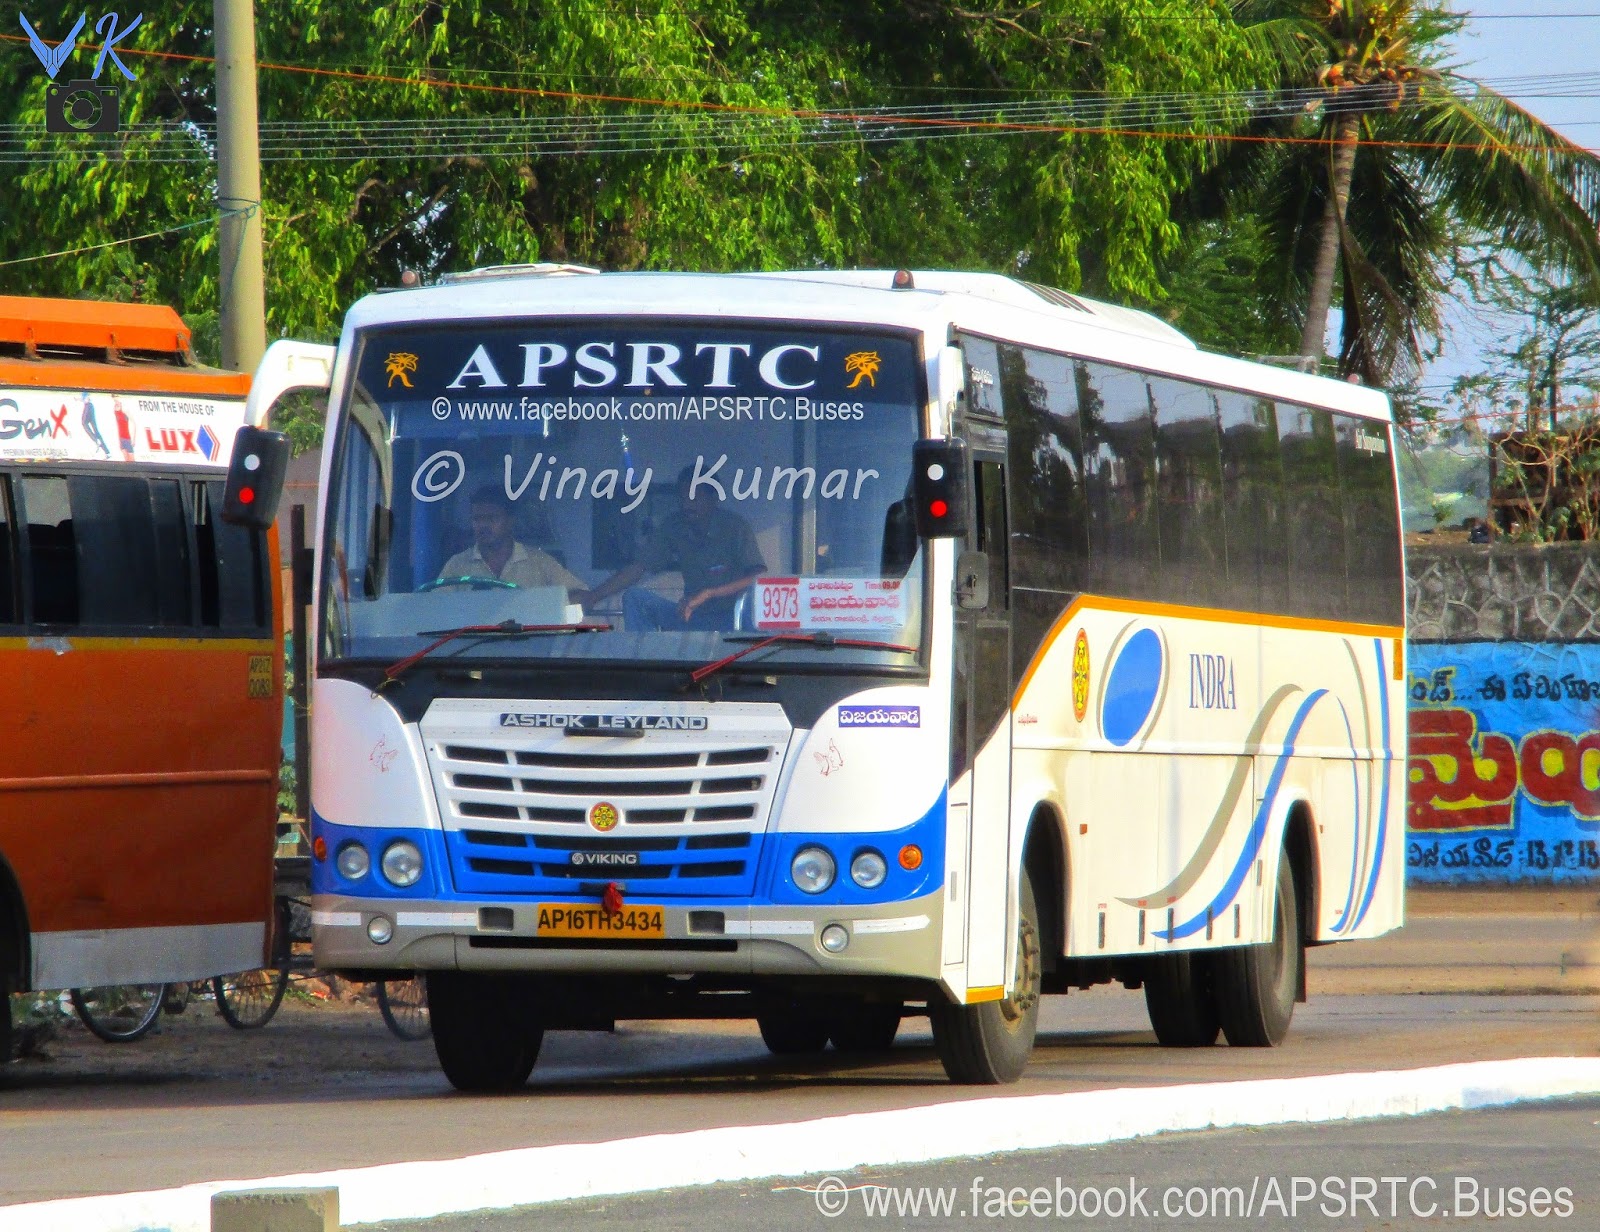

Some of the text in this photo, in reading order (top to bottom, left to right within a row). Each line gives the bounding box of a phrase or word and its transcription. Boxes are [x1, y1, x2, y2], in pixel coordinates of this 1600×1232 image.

[446, 342, 821, 390] APSRTC
[138, 400, 215, 417] FROM THE HOUSE OF
[144, 427, 199, 454] LUX
[763, 586, 799, 619] 9373
[1188, 653, 1237, 710] INDRA
[503, 713, 707, 730] ASHOK LEYLAND
[839, 708, 920, 725] విజయవాడ
[585, 853, 638, 865] VIKING
[538, 908, 663, 932] AP16TH3434
